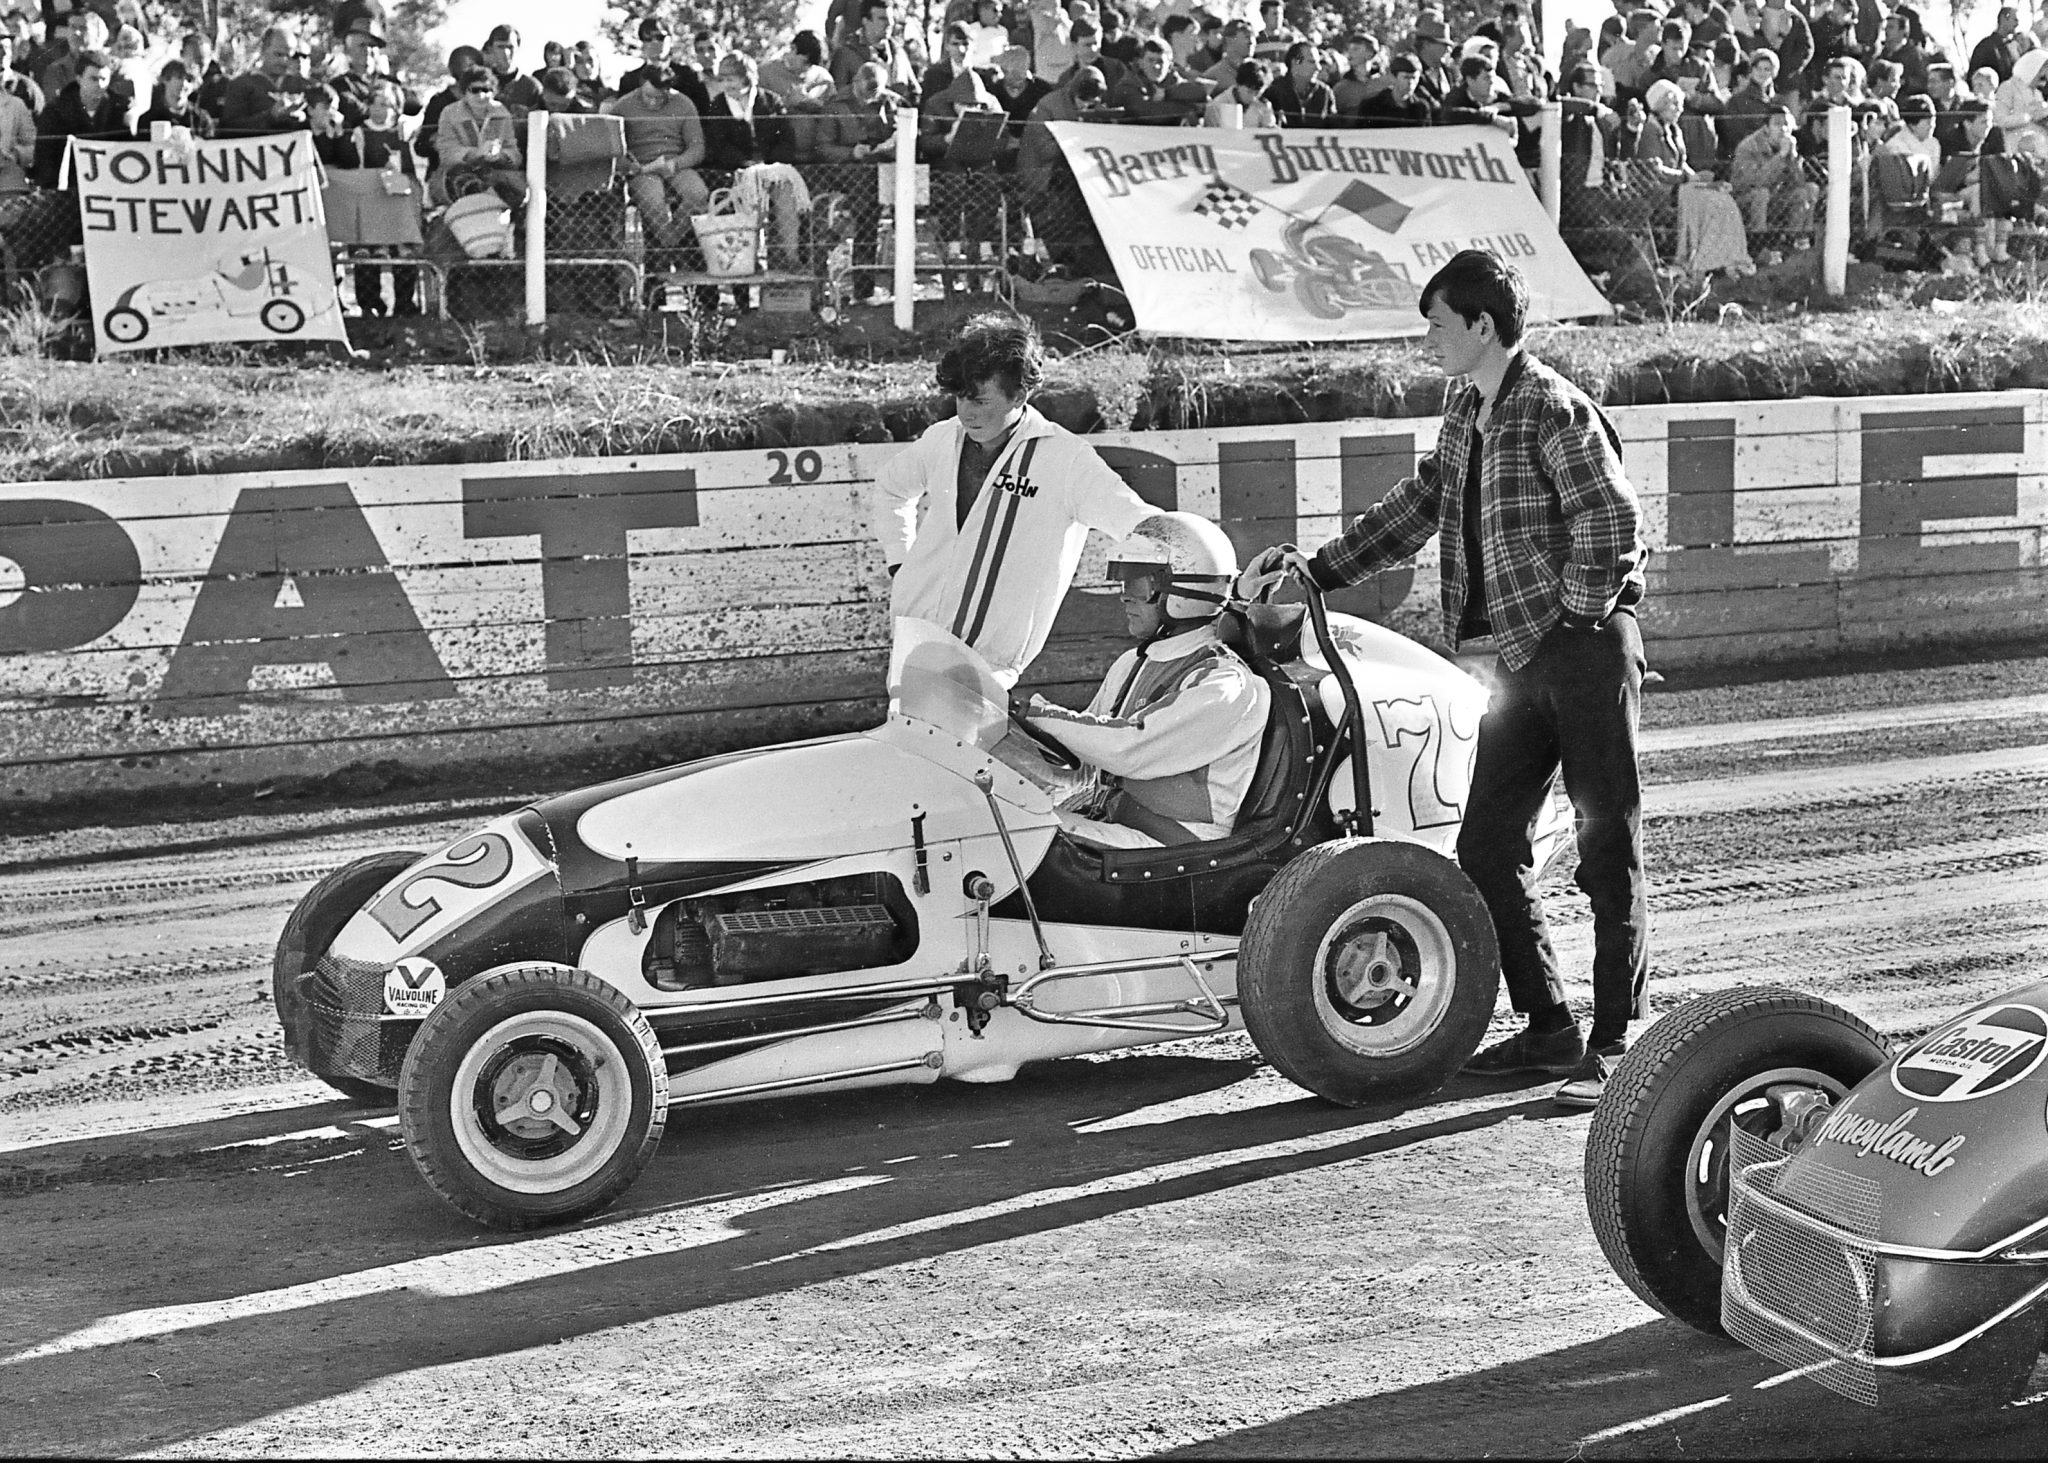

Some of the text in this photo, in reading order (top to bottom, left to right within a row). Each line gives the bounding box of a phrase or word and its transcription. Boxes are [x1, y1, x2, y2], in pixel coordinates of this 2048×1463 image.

[79, 140, 297, 184] JOHNNY
[1084, 134, 1516, 198] Barry Butterworth
[1129, 245, 1237, 273] OFFICIAL
[1412, 240, 1460, 267] FAN
[767, 449, 823, 484] 20
[368, 832, 514, 945] 2
[388, 986, 439, 1005] VALVOLINE
[1922, 1027, 2035, 1071] Castrol
[1928, 1058, 1974, 1070] MOTOR OIL
[1813, 1094, 1967, 1178] Honeylamb
